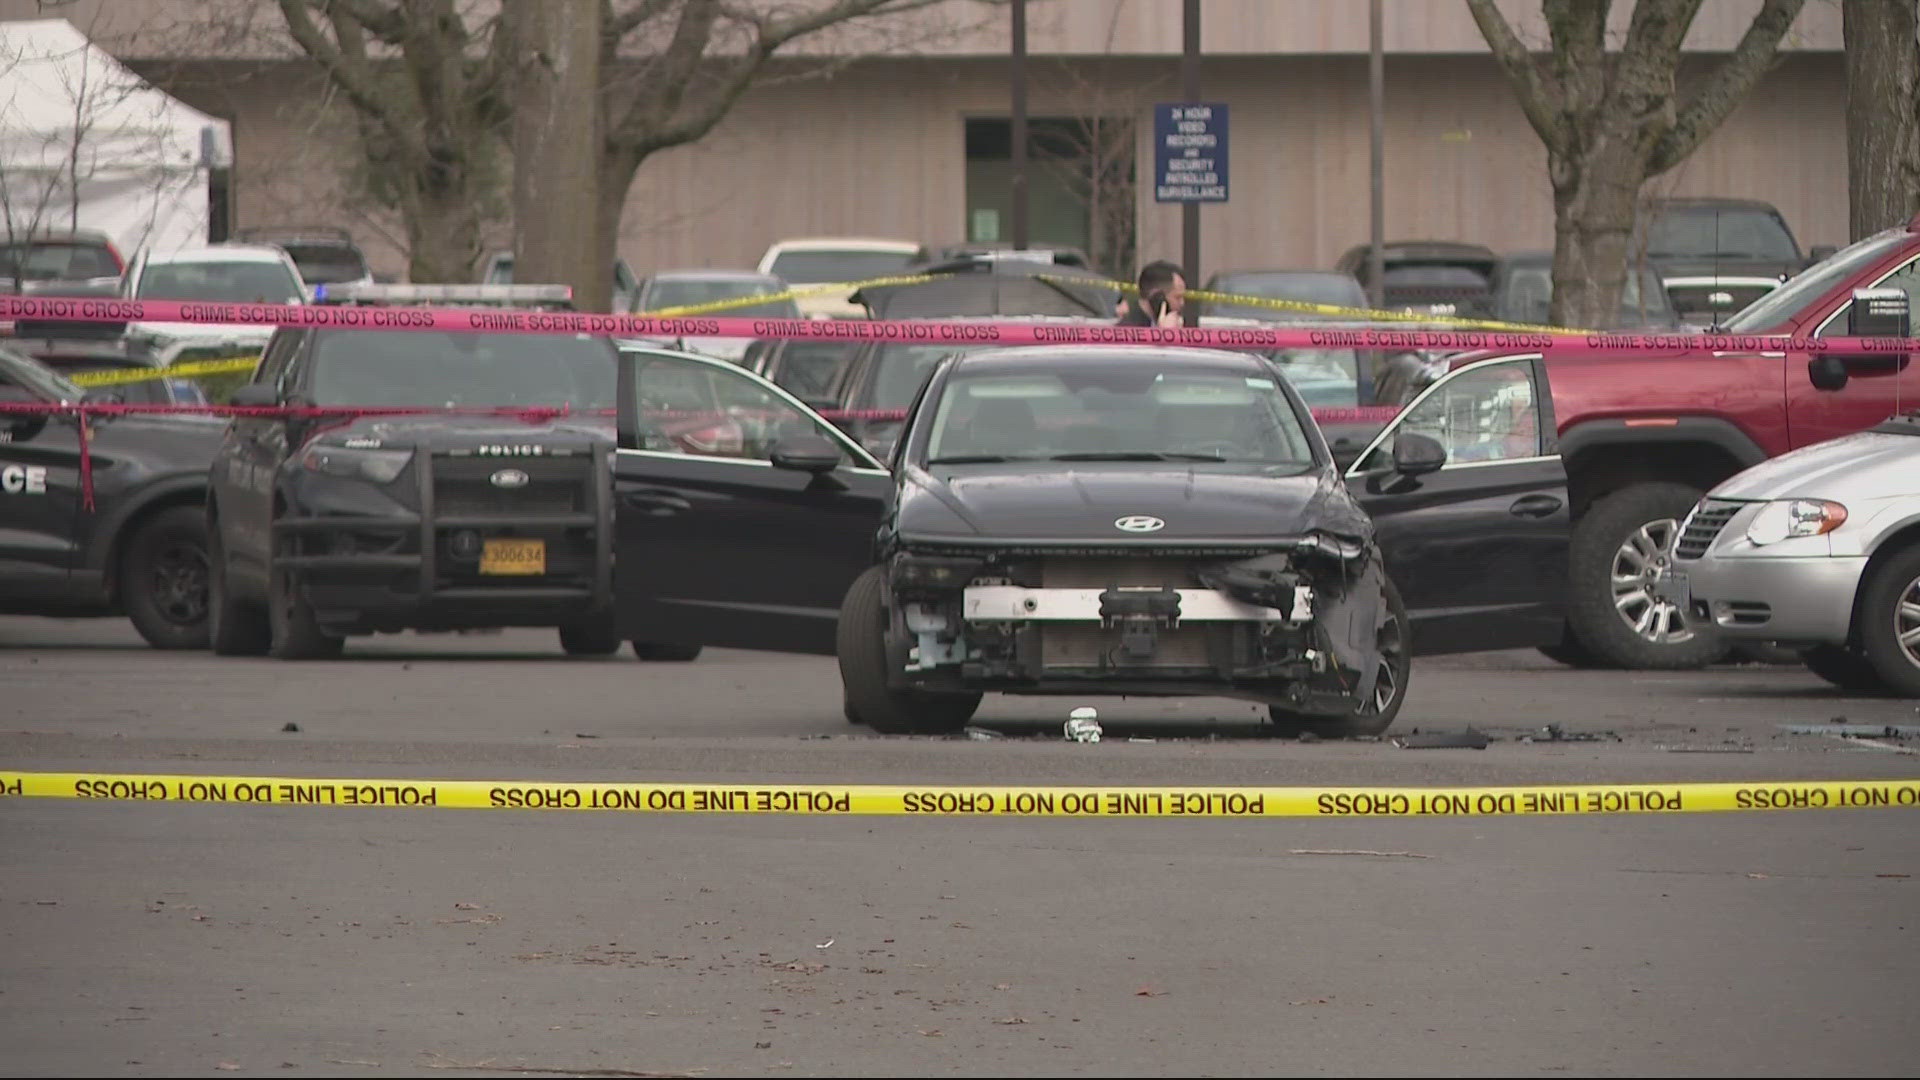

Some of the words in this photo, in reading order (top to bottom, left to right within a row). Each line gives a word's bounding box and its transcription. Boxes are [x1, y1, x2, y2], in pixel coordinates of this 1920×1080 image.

[1184, 107, 1212, 119] HOUR
[1177, 121, 1206, 133] VIDEO
[1168, 159, 1214, 171] SECURITY
[1165, 172, 1218, 184] PATROLLED
[1157, 186, 1225, 199] SURVEILLANCE
[11, 300, 36, 316] DO
[41, 301, 76, 317] NOT
[82, 302, 144, 318] CROSS
[180, 304, 236, 322] CRIME
[240, 306, 299, 323] SCENE
[303, 309, 329, 325] DO
[333, 310, 368, 326] NOT
[373, 311, 434, 327] CROSS
[469, 314, 525, 330] CRIME
[528, 315, 587, 331] SCENE
[591, 317, 616, 333] DO
[620, 318, 655, 334] NOT
[660, 318, 719, 334] CROSS
[753, 321, 808, 336] CRIME
[811, 322, 869, 338] SCENE
[873, 323, 898, 339] DO
[902, 324, 936, 339] NOT
[941, 324, 999, 340] CROSS
[1033, 327, 1087, 342] CRIME
[1090, 327, 1147, 343] SCENE
[1150, 328, 1175, 344] DO
[1179, 329, 1213, 344] NOT
[1218, 329, 1277, 345] CROSS
[1310, 331, 1363, 346] CRIME
[1367, 331, 1423, 346] SCENE
[1427, 332, 1451, 347] DO
[1455, 333, 1490, 347] NOT
[1495, 333, 1553, 348] CROSS
[1586, 336, 1640, 349] CRIME
[1643, 336, 1699, 350] SCENE
[1703, 336, 1727, 350] DO
[1732, 337, 1764, 350] NOT
[1769, 337, 1828, 350] CROSS
[1860, 338, 1913, 351] CRIME
[479, 444, 543, 456] POLICE
[75, 779, 166, 800] CROSS
[175, 782, 227, 801] NOT
[235, 784, 271, 802] DO
[279, 785, 334, 804] LINE
[344, 786, 437, 806] POLICE
[489, 787, 581, 808] CROSS
[588, 788, 641, 809] NOT
[647, 789, 686, 810] DO
[1736, 788, 1829, 810] CROSS
[1841, 787, 1889, 808] NOT
[694, 790, 749, 811] LINE
[757, 791, 850, 812] POLICE
[903, 791, 995, 813] CROSS
[1001, 792, 1055, 814] NOT
[1061, 792, 1099, 814] DO
[1107, 793, 1162, 814] LINE
[1170, 793, 1264, 814] POLICE
[1318, 793, 1407, 815] CROSS
[1416, 793, 1470, 815] NOT
[1477, 793, 1515, 814] DO
[1523, 792, 1580, 814] LINE
[1588, 791, 1682, 813] POLICE
